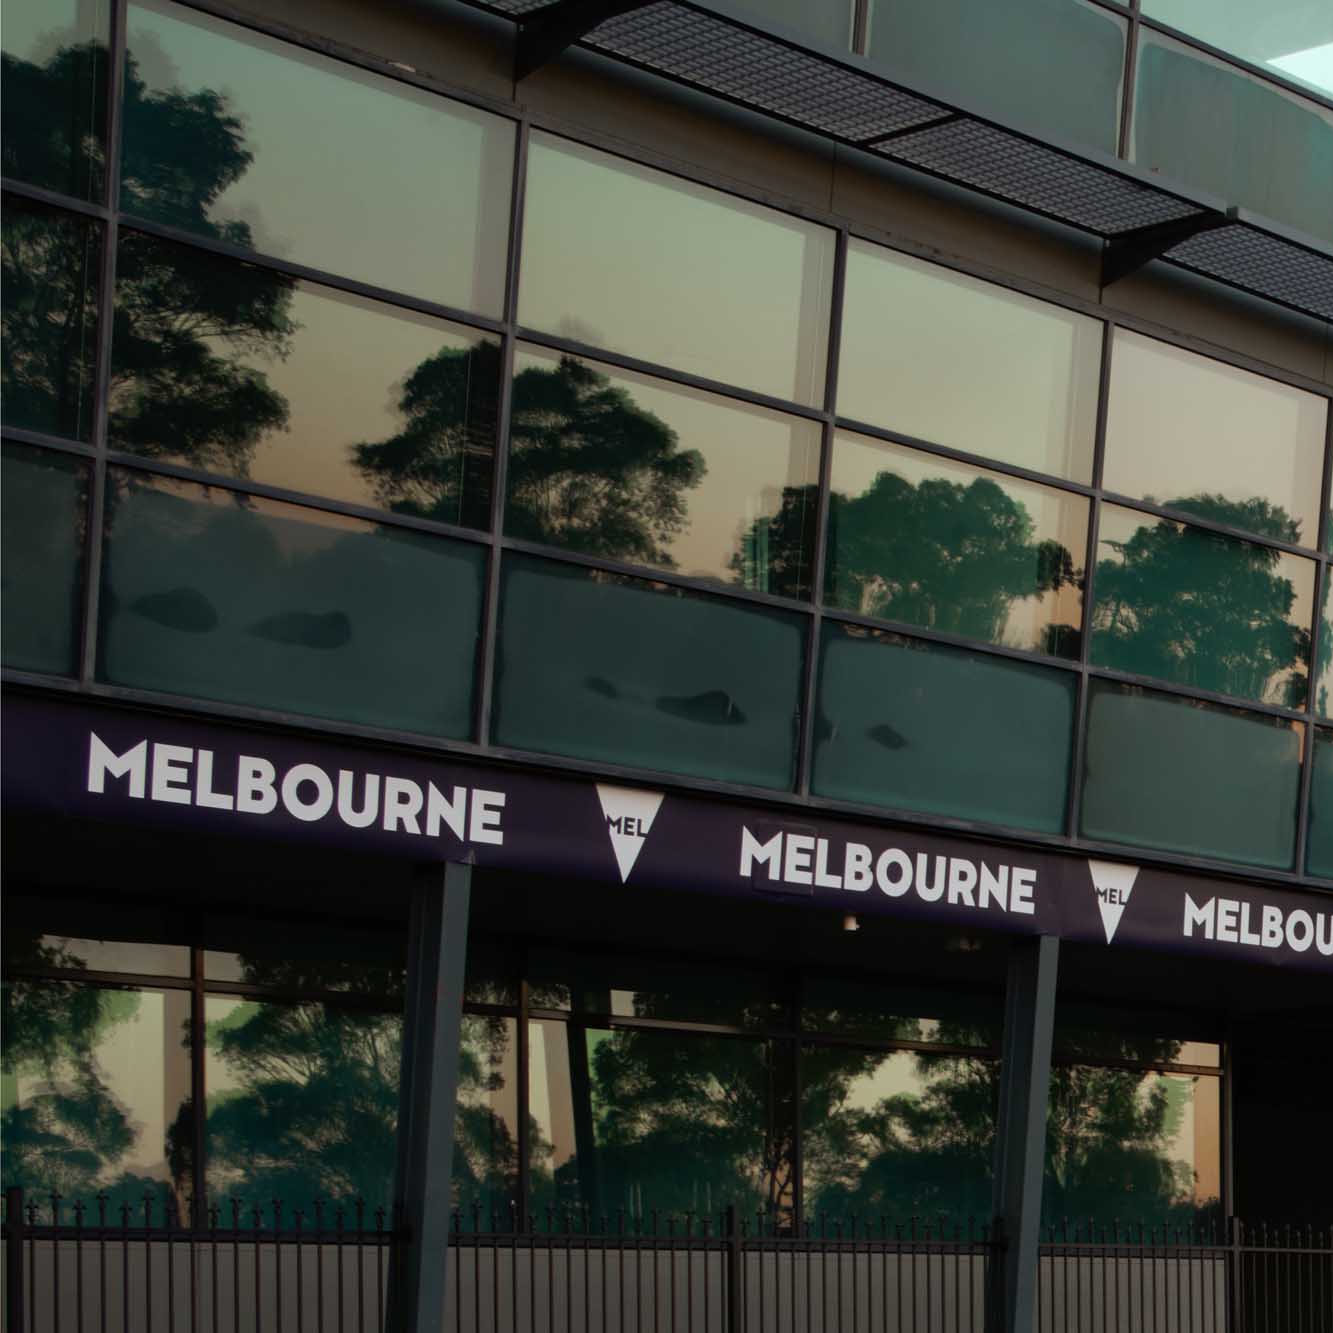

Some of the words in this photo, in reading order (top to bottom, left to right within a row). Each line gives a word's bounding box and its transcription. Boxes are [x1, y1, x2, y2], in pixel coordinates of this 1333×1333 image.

[87, 731, 506, 846] MELBOURNE
[606, 814, 648, 838] MEL
[739, 825, 1037, 915] MELBOURNE
[1096, 886, 1127, 906] MEL
